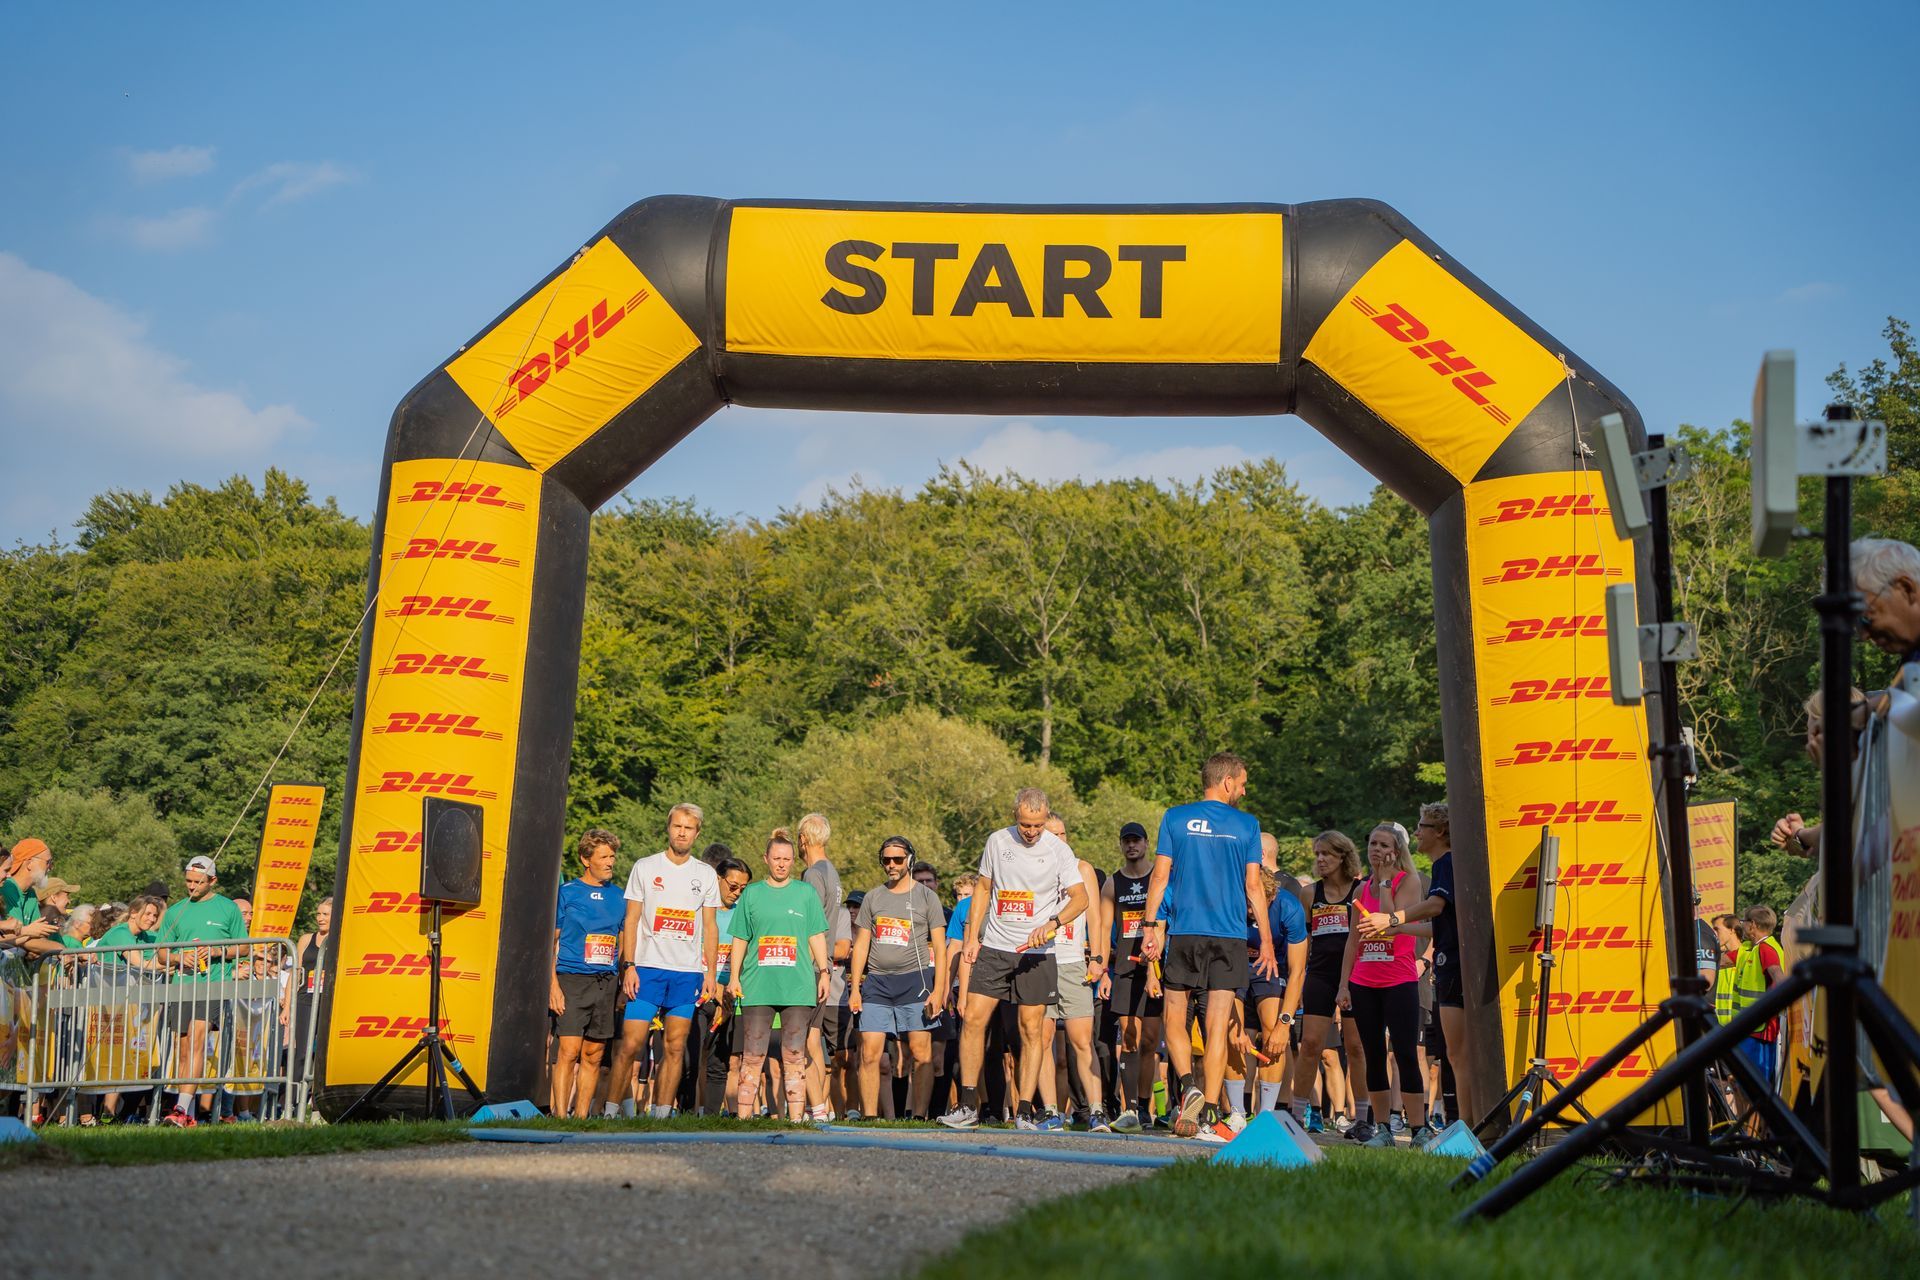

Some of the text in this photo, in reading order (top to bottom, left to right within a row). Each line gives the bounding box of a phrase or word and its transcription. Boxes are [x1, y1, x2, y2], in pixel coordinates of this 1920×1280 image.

[820, 239, 1187, 319] START
[507, 296, 628, 403] DHL
[1371, 302, 1498, 408] DHL
[409, 481, 508, 507] DHL
[1496, 494, 1602, 523] DHL
[404, 538, 502, 564] DHL
[1500, 554, 1608, 582] DHL
[397, 595, 496, 621] DHL
[1504, 615, 1608, 643] DHL
[391, 653, 491, 679] DHL
[1508, 676, 1612, 704] DHL
[384, 711, 486, 737] DHL
[1513, 738, 1620, 766] DHL
[378, 771, 479, 797] DHL
[280, 796, 313, 806] DHL
[1518, 800, 1624, 828] DHL
[276, 817, 309, 827] DHL
[1186, 819, 1212, 833] GL
[272, 839, 306, 849] DHL
[270, 860, 303, 870] DHL
[267, 881, 300, 892] DHL
[590, 892, 604, 900] GL
[1118, 893, 1148, 903] SAYSK
[1002, 902, 1026, 912] 2428
[662, 919, 687, 930] 2277
[881, 927, 903, 937] 2189
[1318, 915, 1341, 926] 2038
[766, 947, 789, 957] 2151
[1363, 942, 1386, 952] 2060
[1527, 926, 1635, 952] DHL
[360, 953, 462, 978] DHL
[1533, 990, 1641, 1016] DHL
[353, 1015, 456, 1041] DHL
